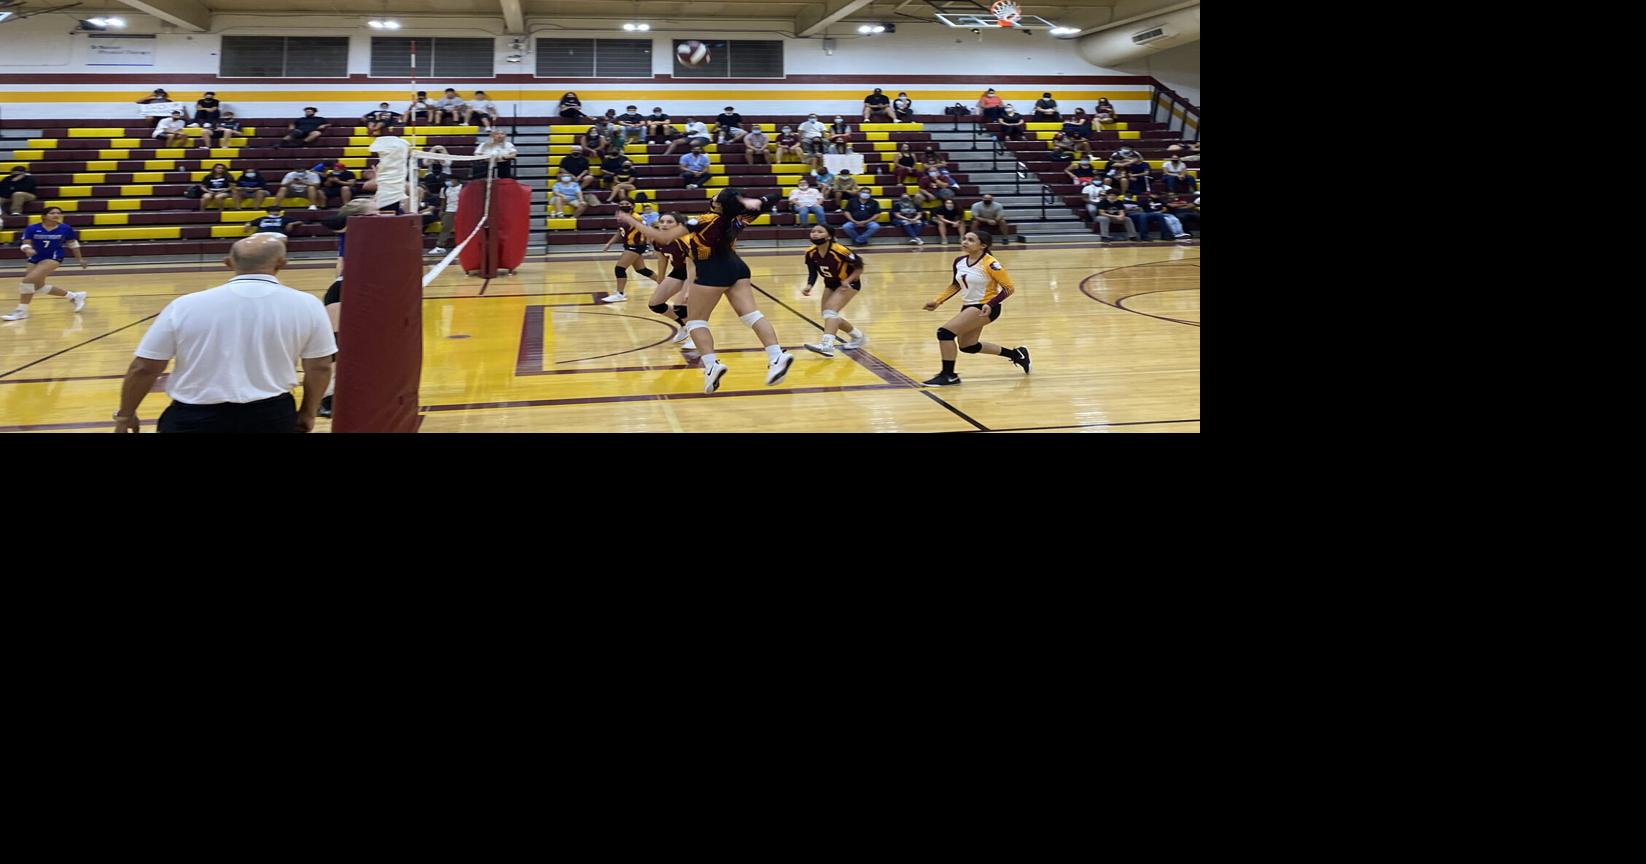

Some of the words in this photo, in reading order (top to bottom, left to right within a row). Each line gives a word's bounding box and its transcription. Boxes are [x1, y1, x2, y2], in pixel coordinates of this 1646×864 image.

[43, 240, 50, 249] 7
[820, 265, 833, 278] 5
[961, 273, 969, 289] 1
